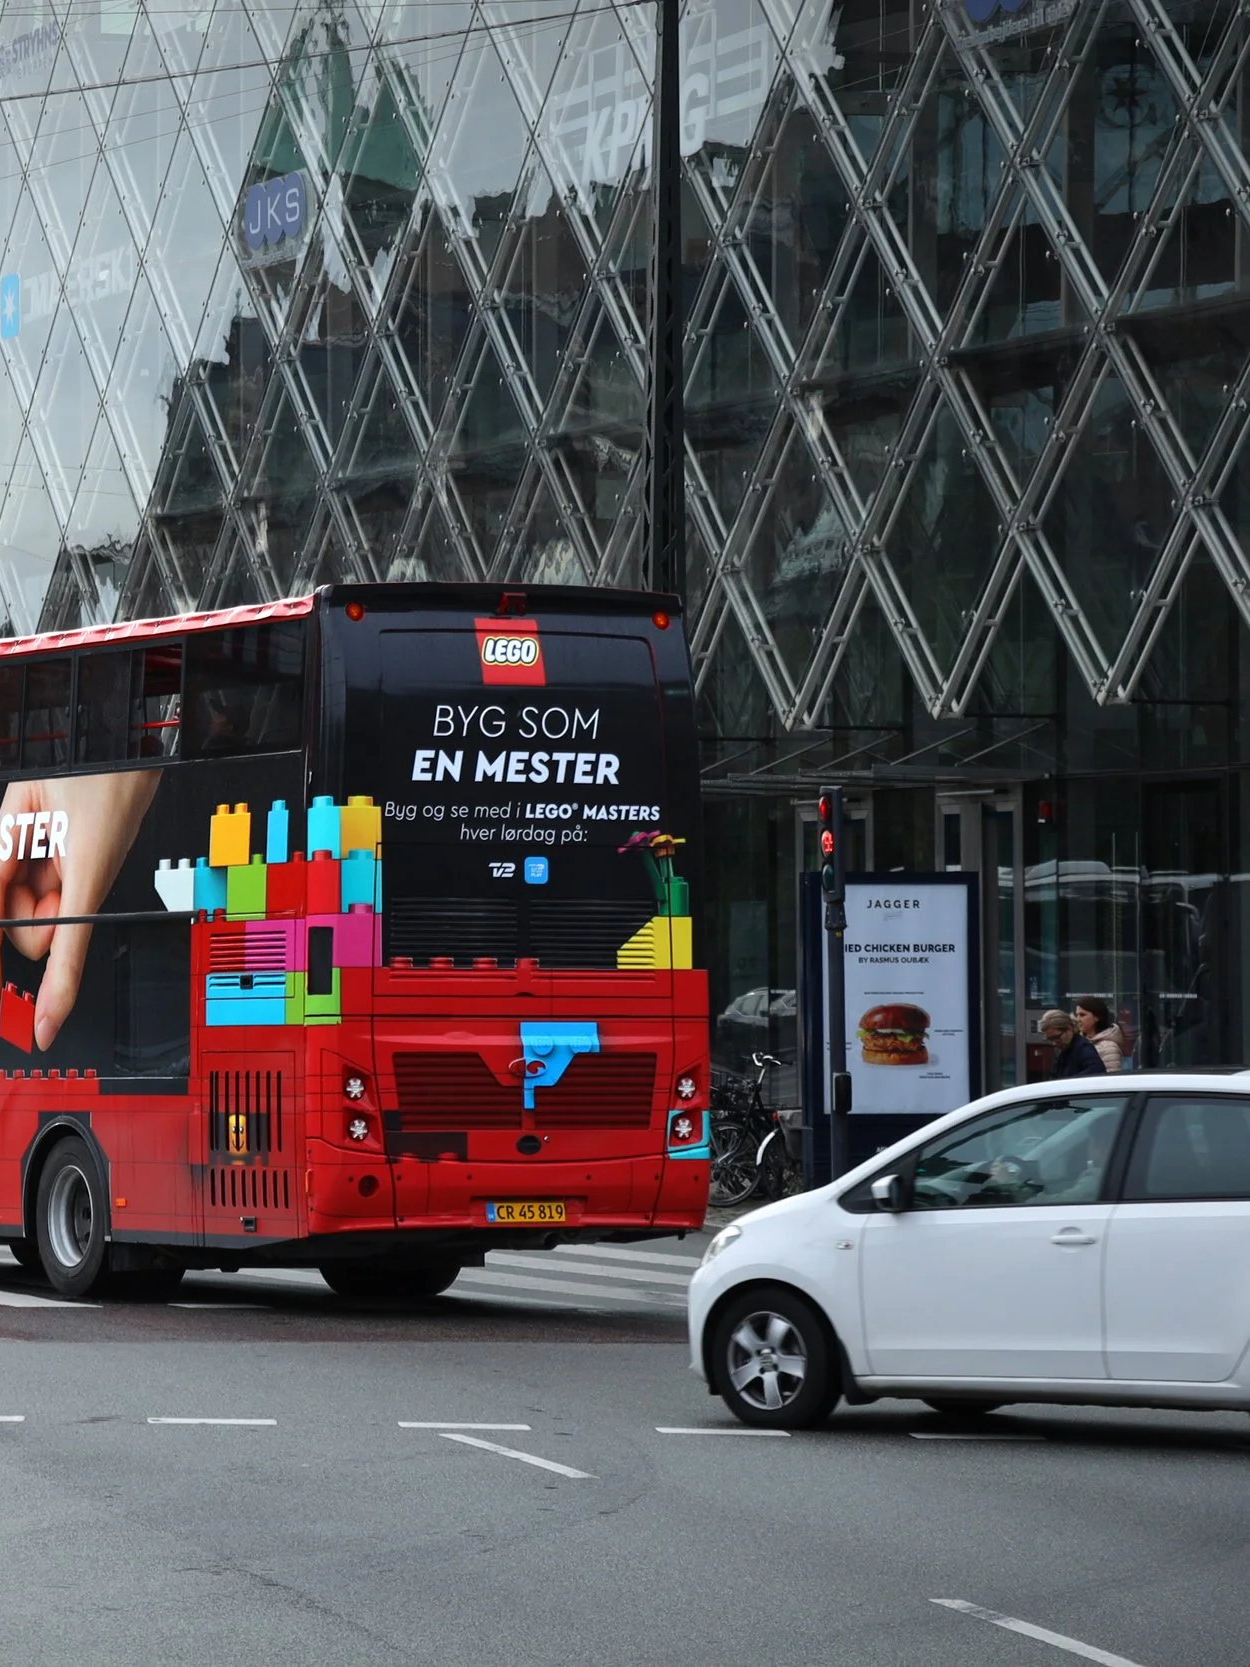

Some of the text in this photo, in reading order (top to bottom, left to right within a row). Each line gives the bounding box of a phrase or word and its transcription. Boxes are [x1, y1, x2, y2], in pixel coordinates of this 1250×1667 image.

[249, 187, 300, 235] JKS
[483, 637, 537, 665] LEGO
[433, 705, 600, 739] BYG SOM
[411, 750, 620, 784] EN MESTER
[384, 801, 417, 820] Byg
[422, 805, 445, 821] og
[450, 806, 469, 818] se
[474, 802, 512, 818] med
[515, 802, 521, 819] i
[582, 804, 661, 821] MASTERS
[460, 824, 588, 845] hver lørdag på:
[866, 899, 920, 909] JAGGER
[845, 944, 955, 953] IED CHICKEN BURGER
[496, 1204, 563, 1220] CR 45 819
